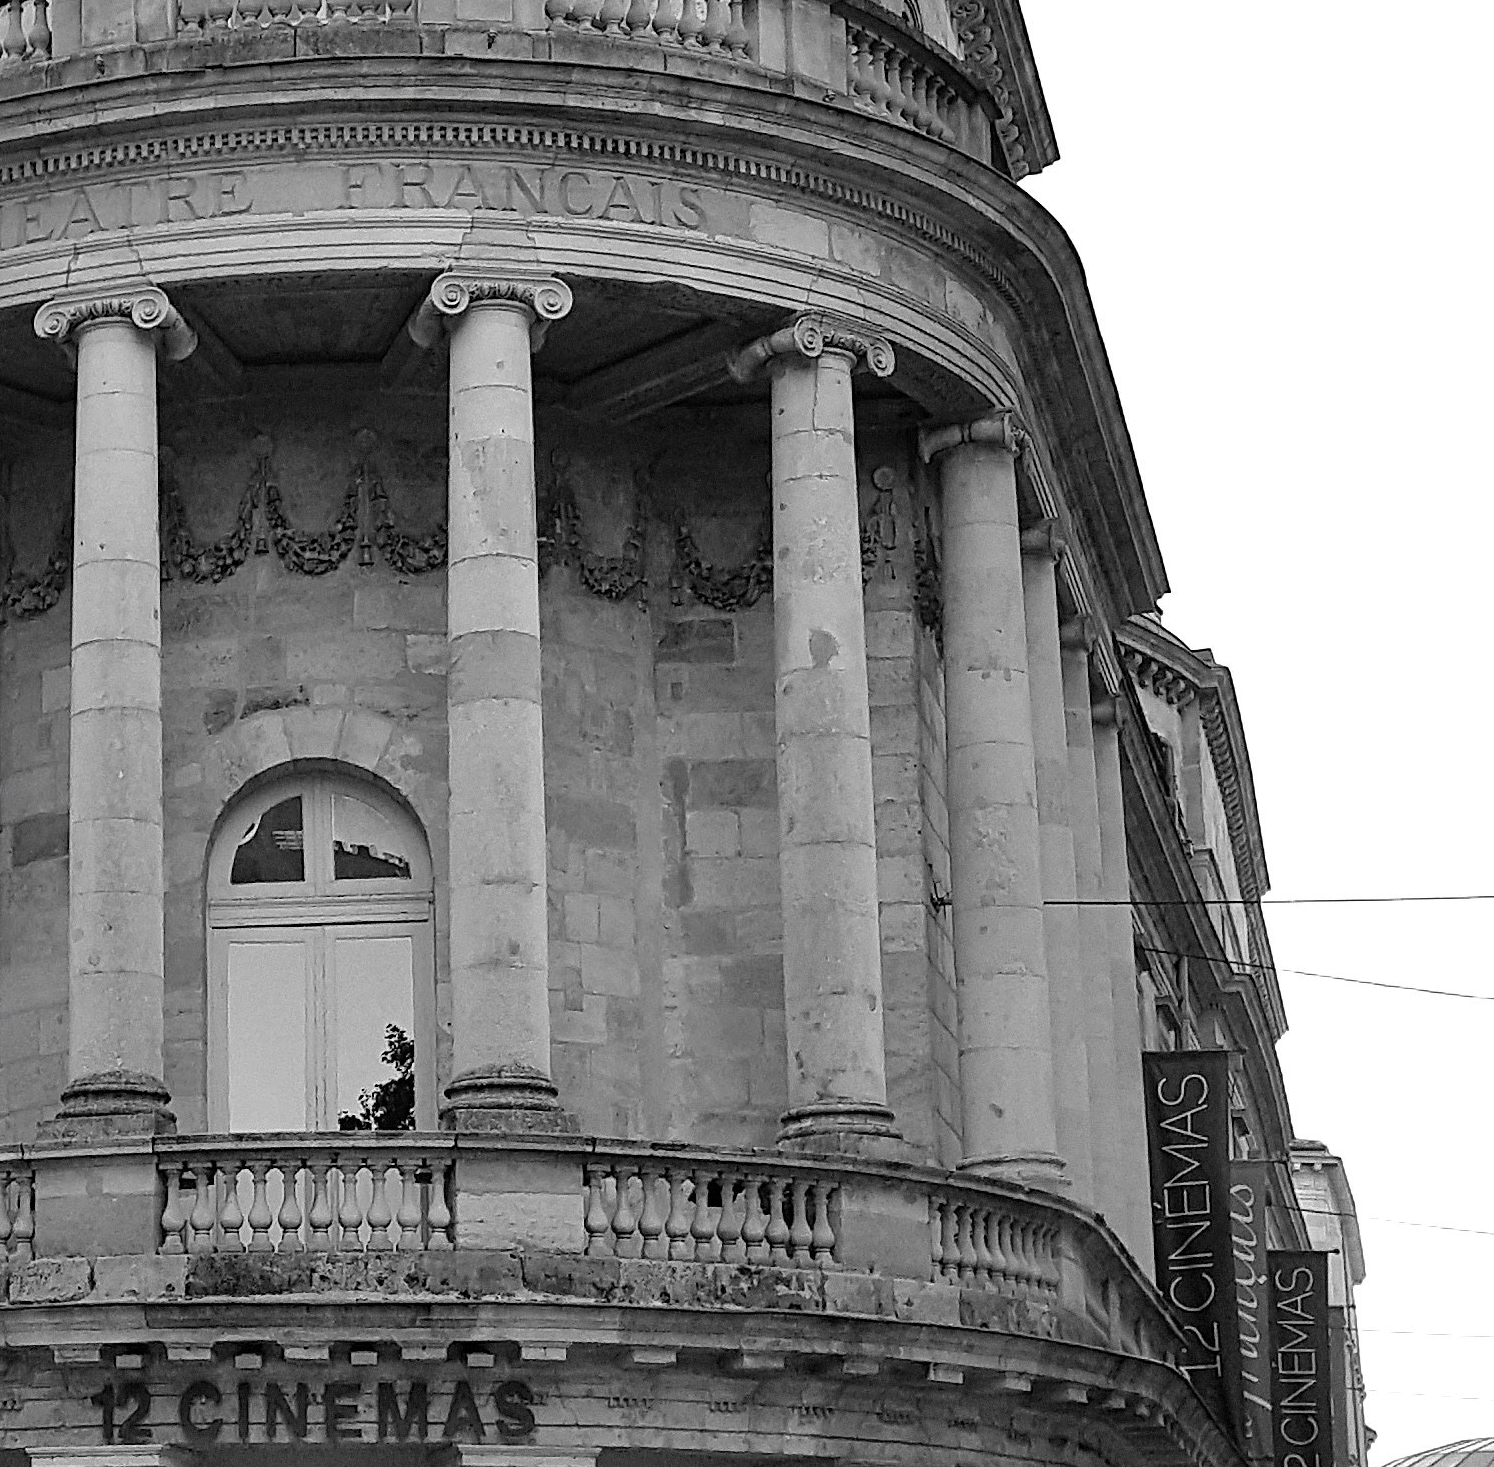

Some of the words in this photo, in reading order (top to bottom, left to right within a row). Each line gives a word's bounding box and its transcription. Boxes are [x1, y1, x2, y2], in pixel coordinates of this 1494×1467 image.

[336, 160, 707, 231] FRANCAIS
[1152, 1073, 1216, 1312] CINÉMAS
[1178, 1321, 1222, 1377] 12
[1272, 1267, 1320, 1446] CINÉMAS
[91, 1381, 153, 1441] 12
[178, 1379, 536, 1441] CINEMAS
